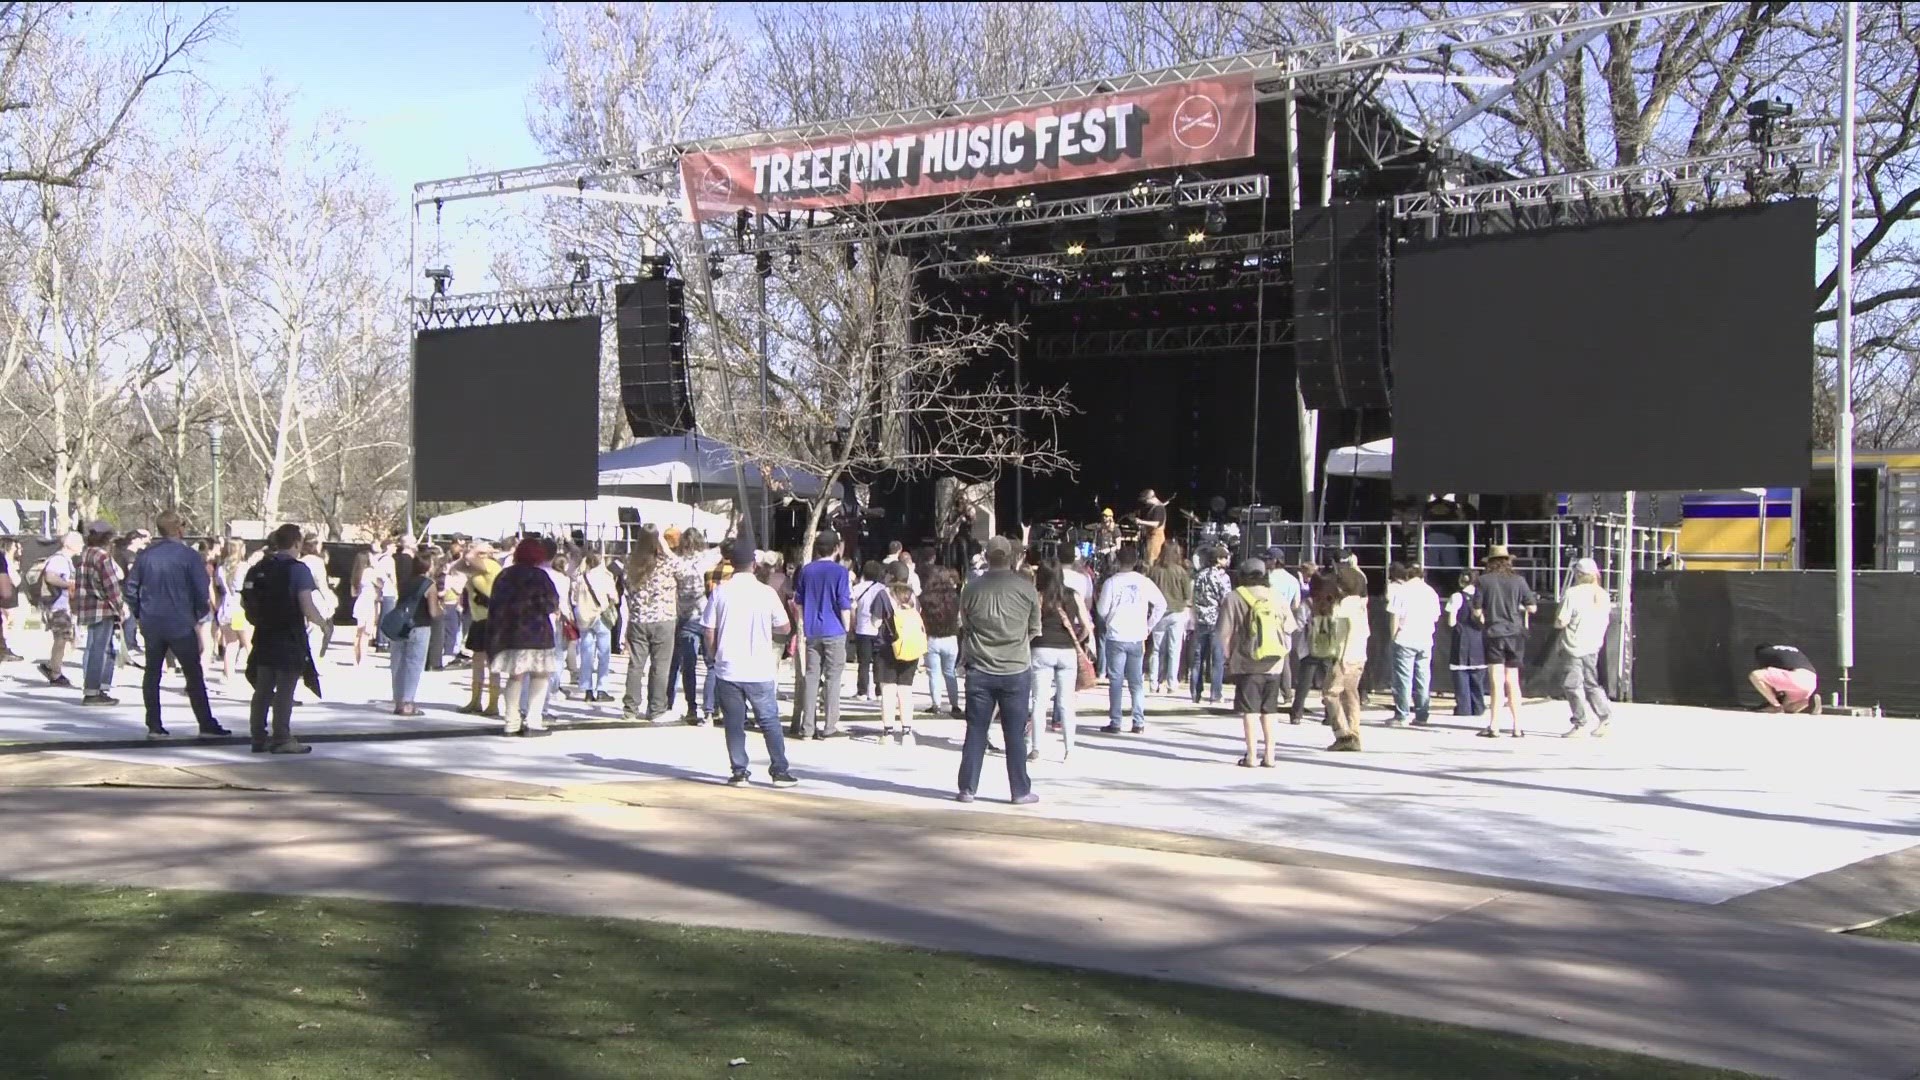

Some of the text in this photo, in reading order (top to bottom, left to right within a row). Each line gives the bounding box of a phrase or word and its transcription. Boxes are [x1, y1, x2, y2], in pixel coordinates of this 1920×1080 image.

[751, 102, 1133, 194] TREEFORT MUSIC FEST
